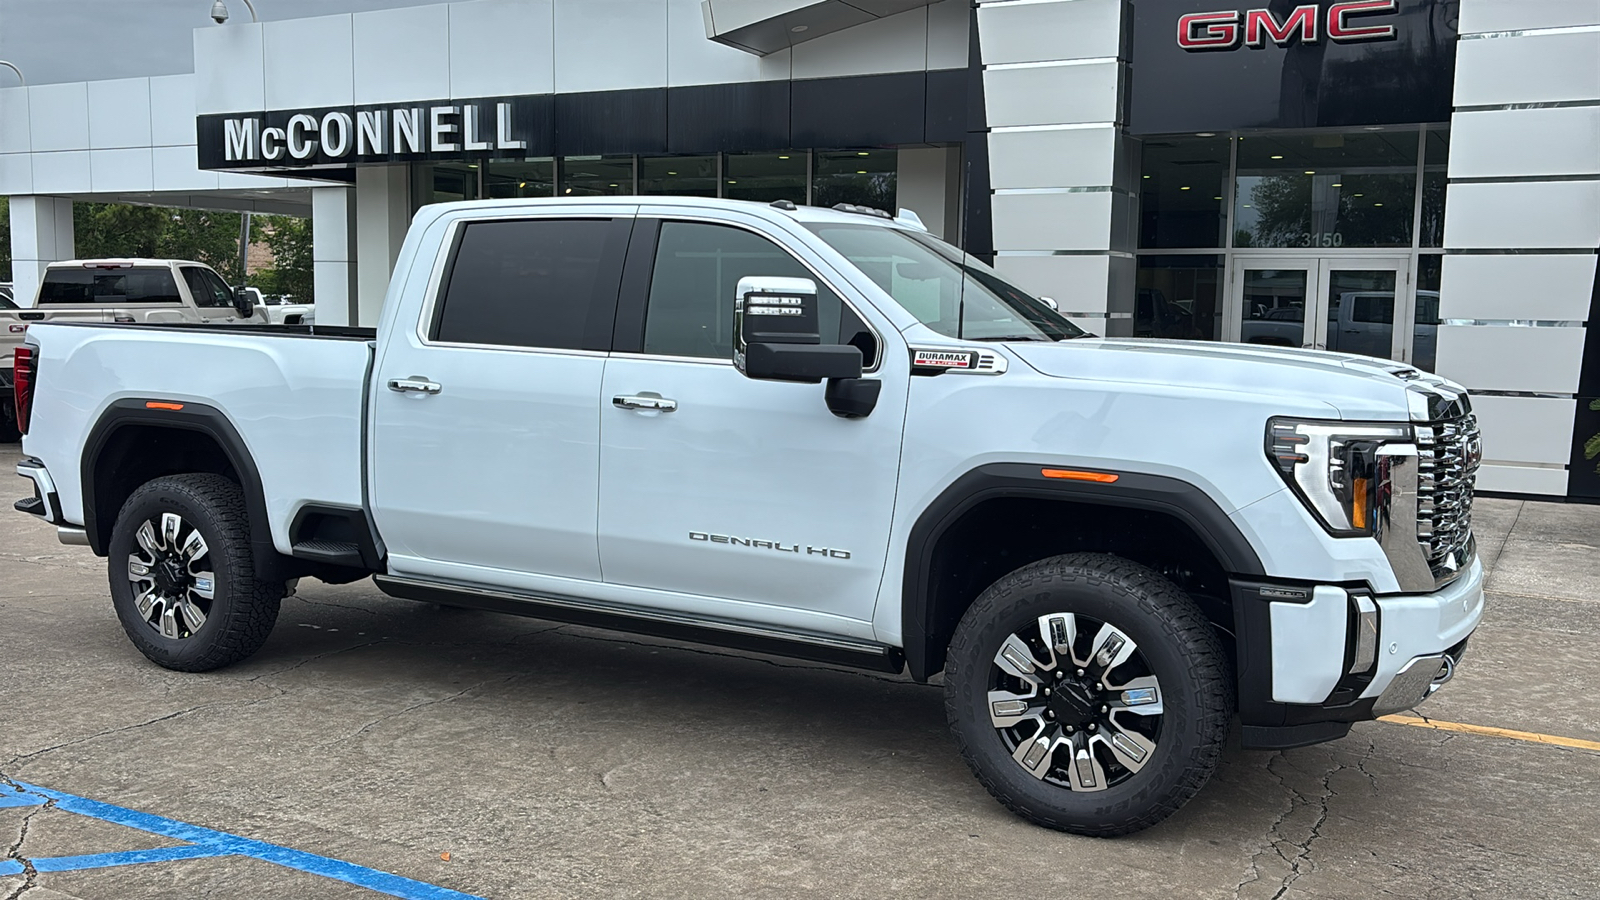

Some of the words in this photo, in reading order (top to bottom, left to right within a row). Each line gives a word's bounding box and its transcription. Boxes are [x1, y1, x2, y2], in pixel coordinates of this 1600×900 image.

[1177, 0, 1397, 49] GMC
[224, 102, 526, 161] McCONNELL
[1301, 232, 1343, 248] 3150
[918, 352, 967, 362] DURAMAX
[689, 530, 800, 553] DENALI
[807, 545, 851, 560] HD
